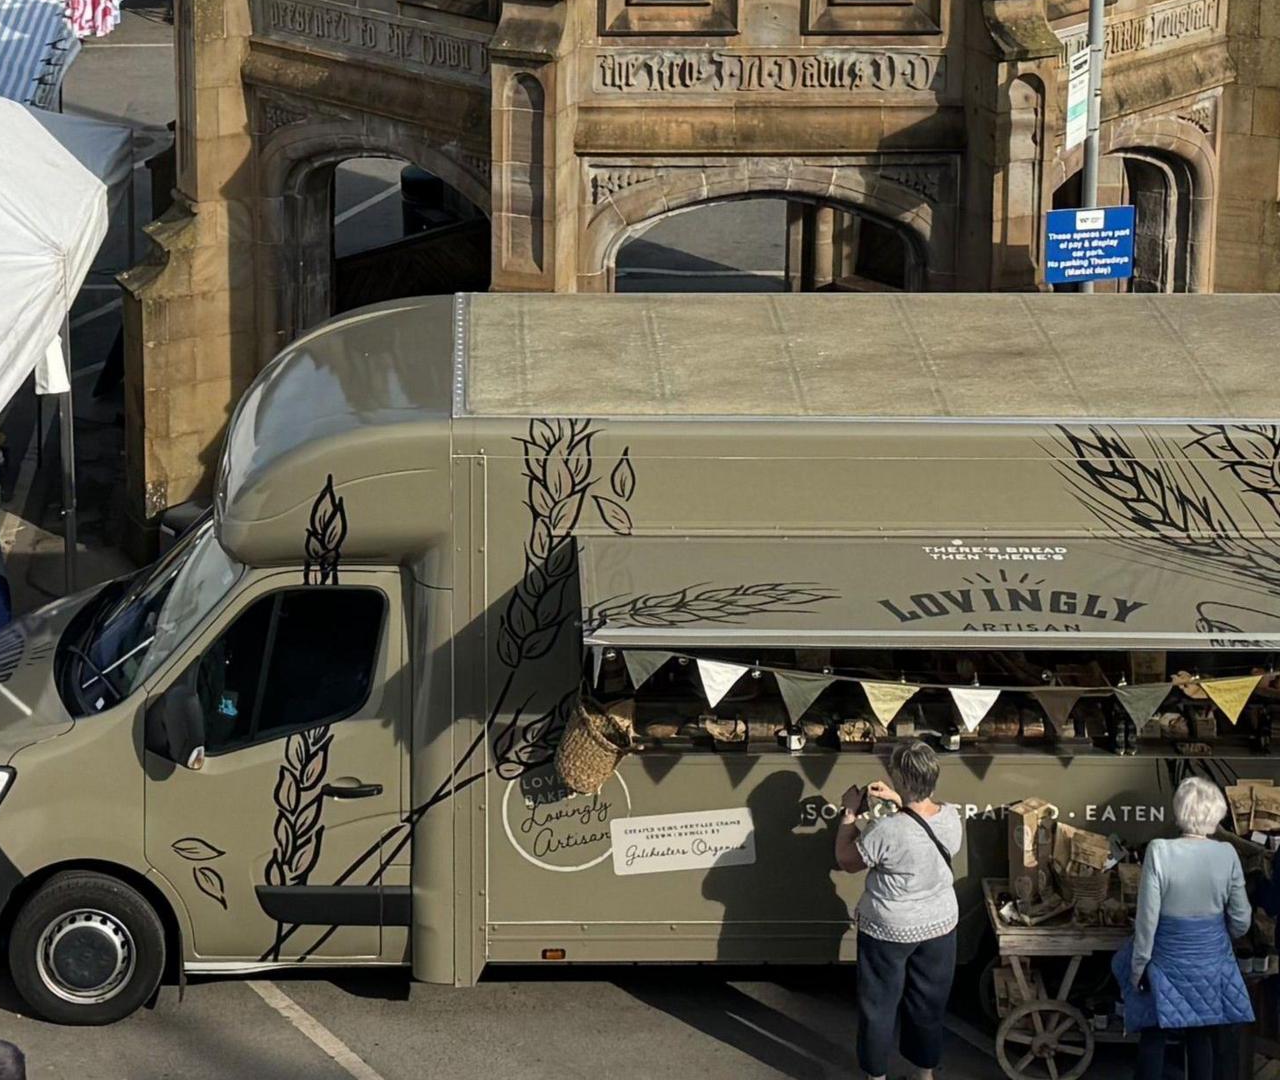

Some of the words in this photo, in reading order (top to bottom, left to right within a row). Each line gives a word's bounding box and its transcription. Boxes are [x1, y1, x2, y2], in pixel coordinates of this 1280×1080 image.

[922, 546, 999, 554] THERE'S
[1005, 546, 1067, 554] BREAD
[930, 553, 980, 561] THEN
[985, 553, 1065, 561] THERE'S
[877, 588, 1150, 623] LOVINGLY
[963, 623, 1081, 632] ARTISAN
[521, 793, 612, 833] Lovingly
[1086, 804, 1165, 821] EATEN
